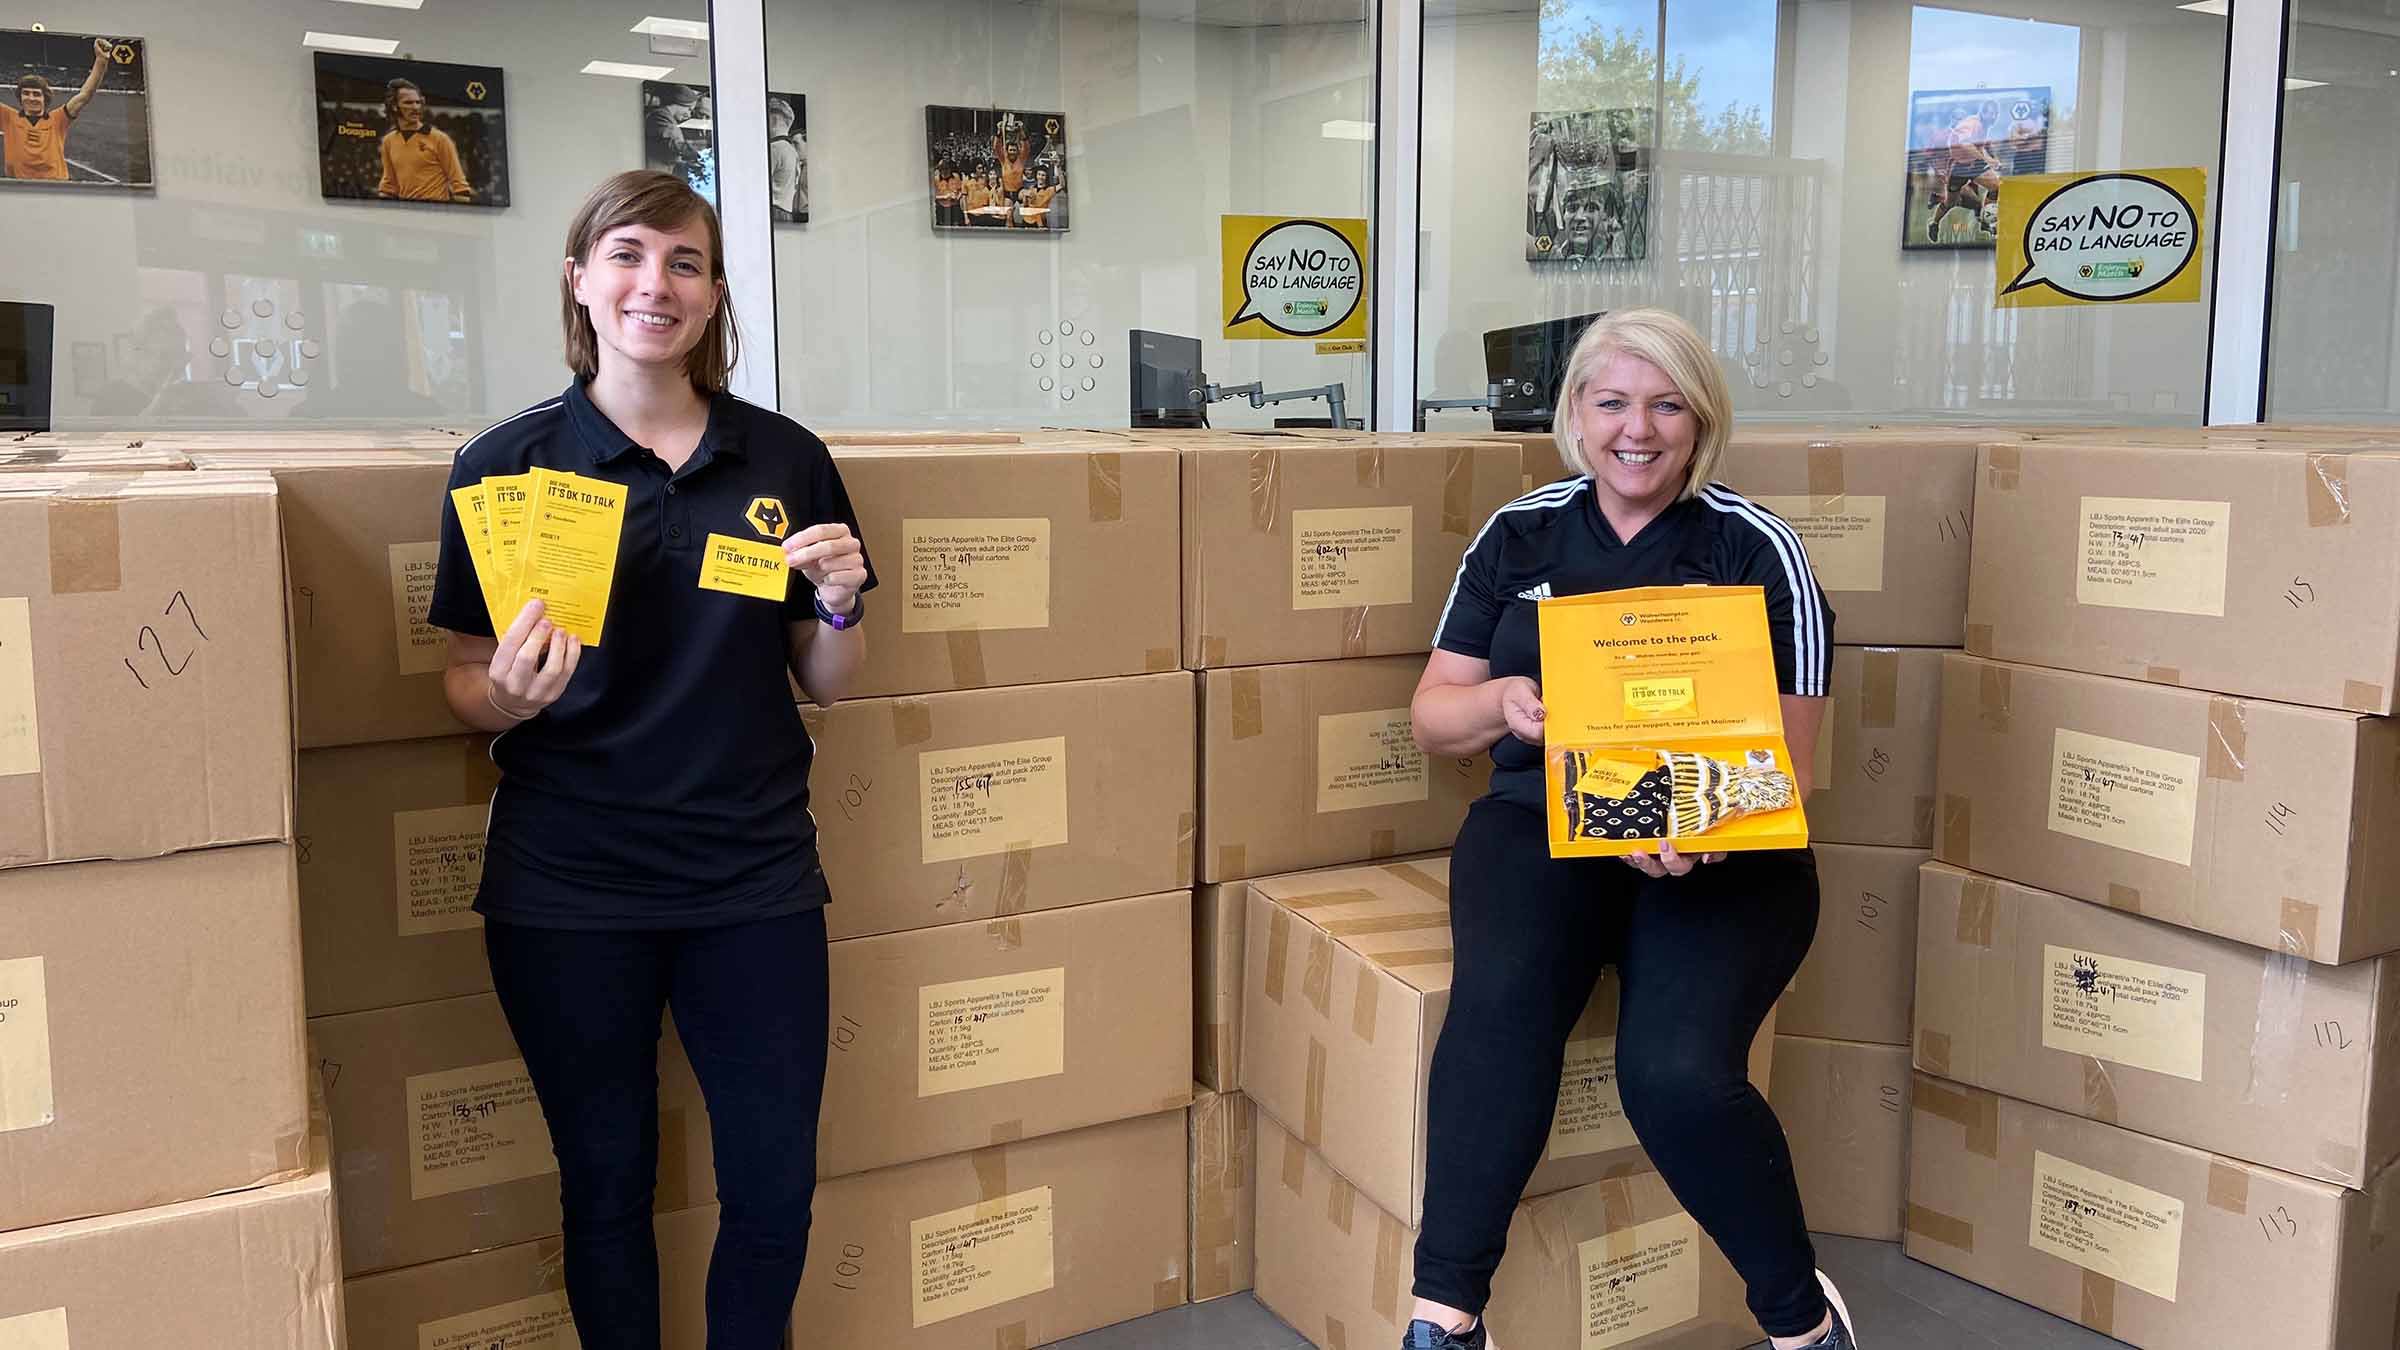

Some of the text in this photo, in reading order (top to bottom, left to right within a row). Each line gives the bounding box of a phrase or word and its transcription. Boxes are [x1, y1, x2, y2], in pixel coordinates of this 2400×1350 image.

[338, 125, 376, 138] Dougan
[2042, 205, 2179, 232] SAY NO TO
[2034, 232, 2186, 252] BAD LANGUAGE
[1255, 249, 1350, 272] SAY NO TO
[1250, 275, 1356, 289] BAD LANGUAGE
[497, 492, 515, 502] IT'S
[548, 486, 565, 498] IT'S
[566, 490, 578, 501] OK
[581, 493, 592, 503] TO
[594, 496, 615, 509] TALK
[928, 536, 950, 544] Sports
[1016, 536, 1037, 544] Group
[996, 545, 1011, 553] pack
[716, 550, 780, 571] IT'S OK TO TALK
[2284, 576, 2315, 609] 115
[1593, 639, 1648, 648] Welcome
[1650, 637, 1664, 645] to
[1667, 635, 1687, 644] the
[2162, 774, 2184, 786] Group
[837, 773, 872, 821] 102
[2313, 1021, 2352, 1049] 112
[2259, 1206, 2296, 1242] 113
